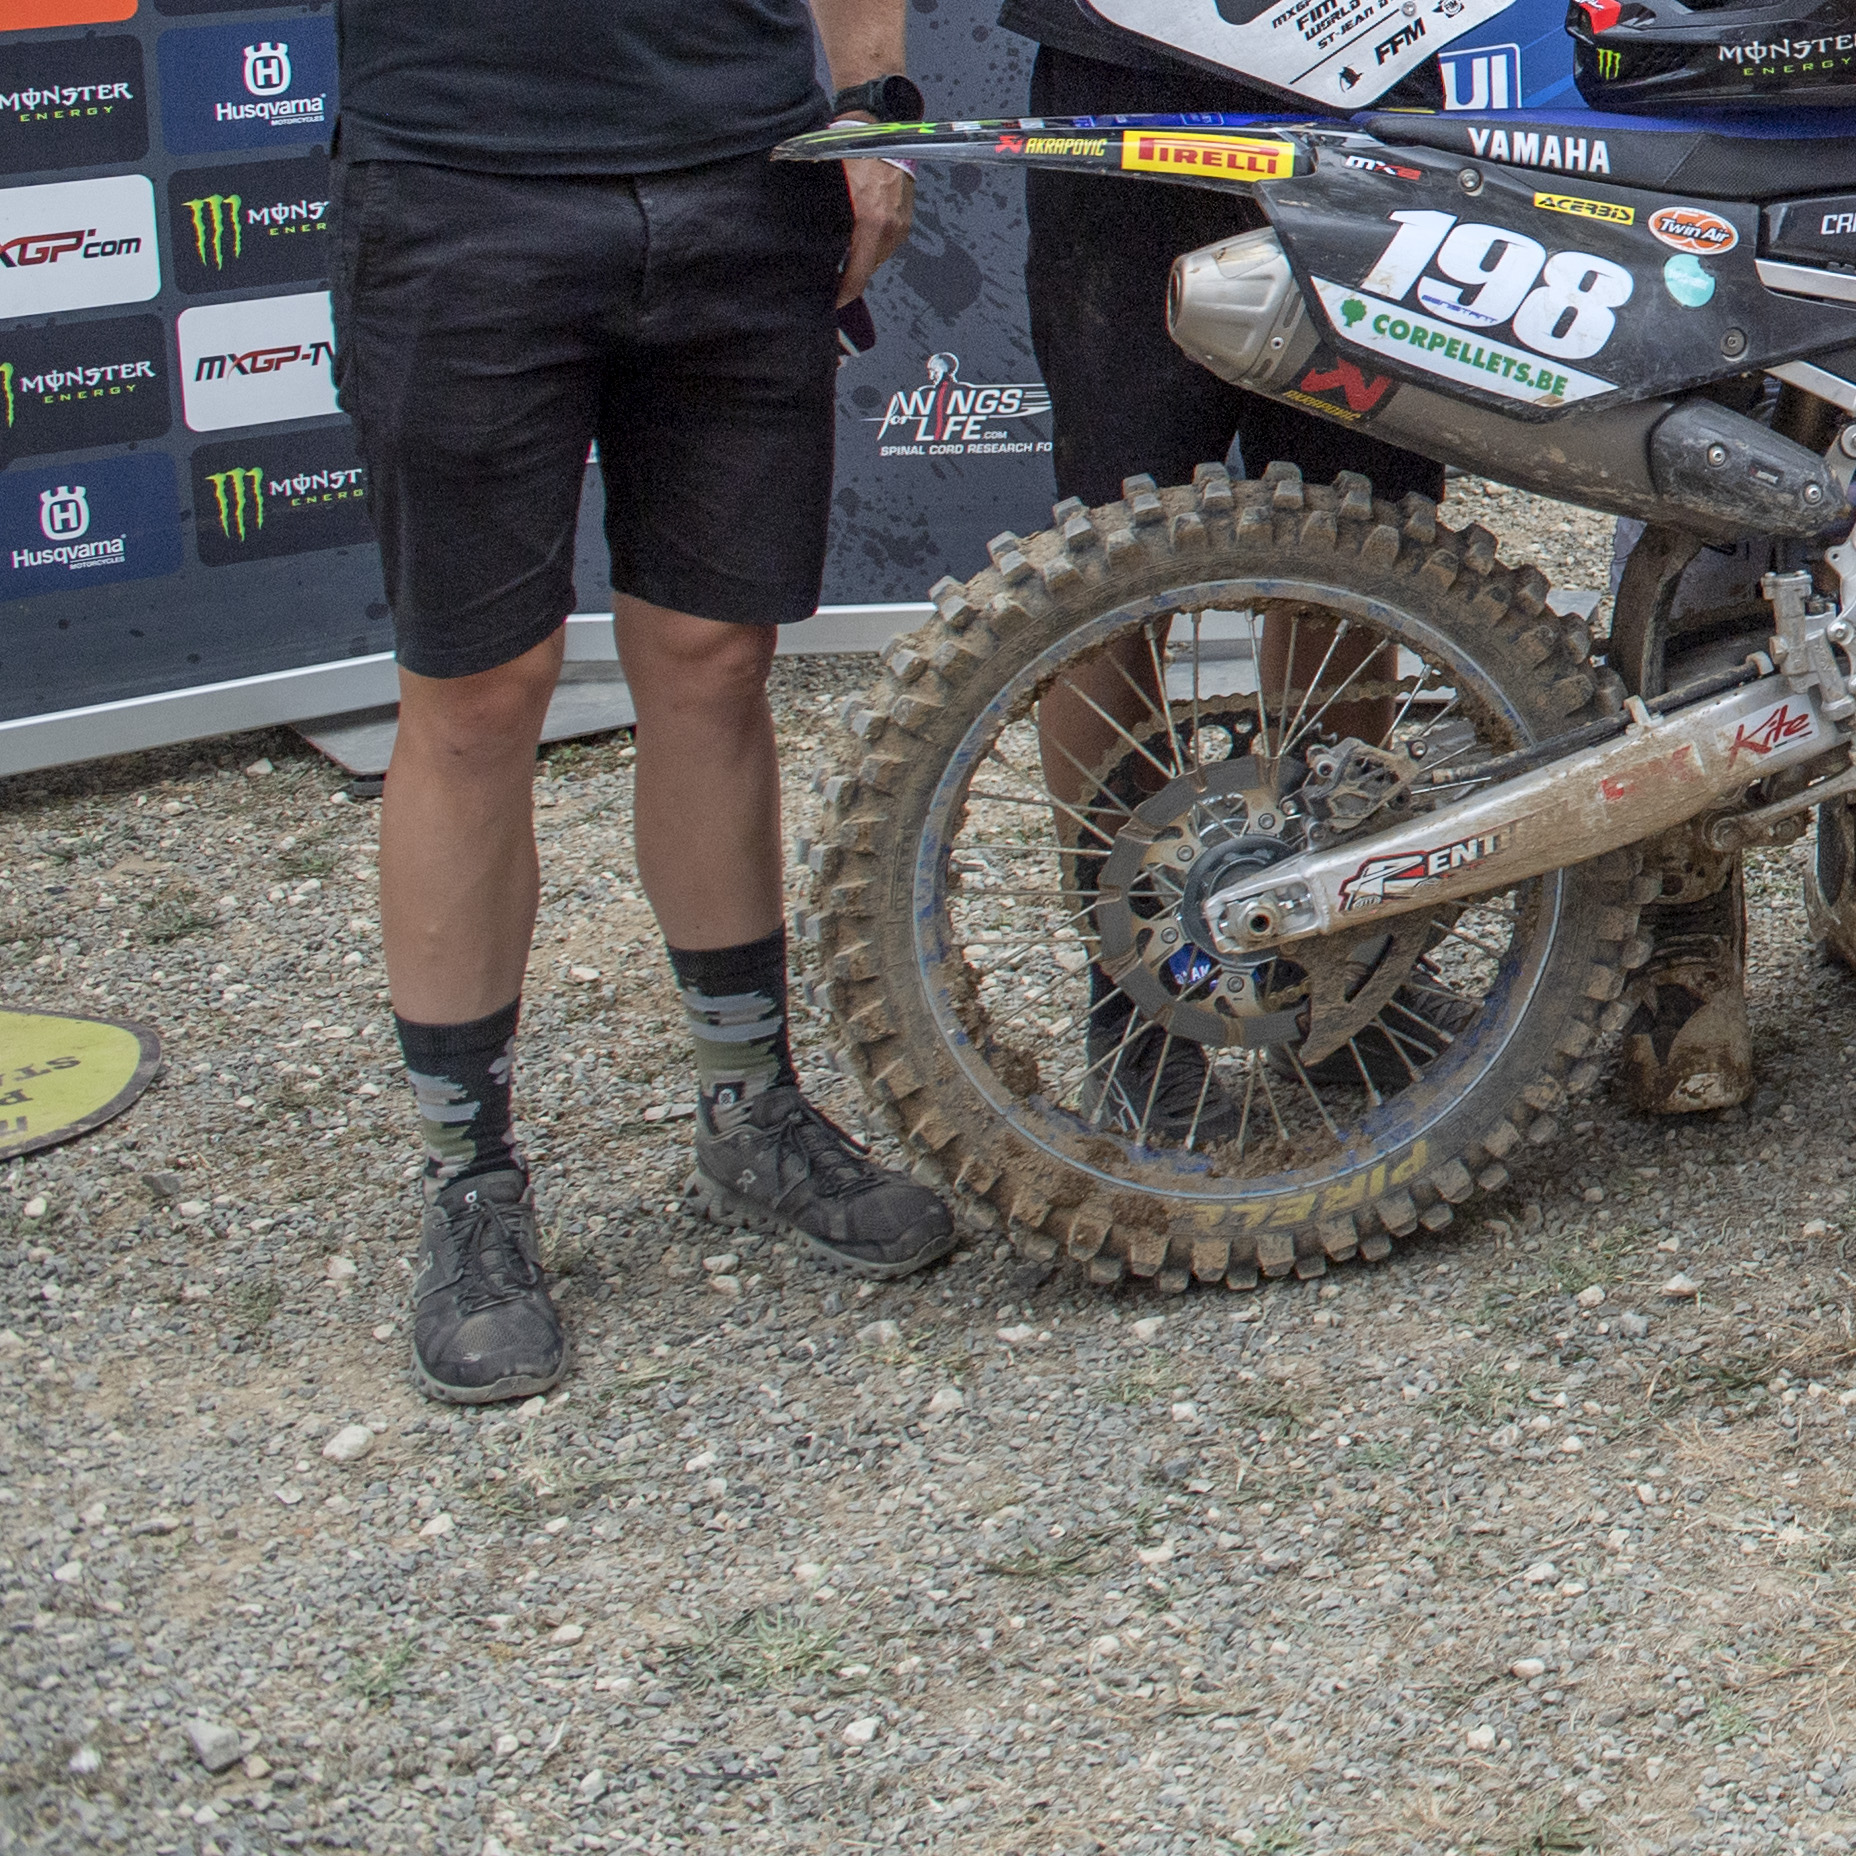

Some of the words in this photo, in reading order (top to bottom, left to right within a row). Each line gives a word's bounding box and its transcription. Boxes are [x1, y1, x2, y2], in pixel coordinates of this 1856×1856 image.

[1317, 7, 1373, 49] ST-JEAN
[1374, 17, 1426, 66] FFM
[1744, 56, 1852, 77] ENERGY
[20, 106, 112, 122] ENERGY
[216, 96, 325, 122] Husqvarna
[1139, 136, 1280, 176] PIRELLI
[1468, 127, 1610, 174] YAMAHA
[1538, 196, 1632, 221] ACERBIS
[1658, 218, 1702, 238] Twin
[1701, 227, 1729, 243] Air
[1361, 208, 1633, 359] 198
[1373, 313, 1568, 397] CORPELLETS.BE
[20, 361, 155, 393] MONSTER
[45, 384, 137, 403] ENERGY
[897, 389, 1023, 416] WINGS
[915, 416, 987, 441] LIFE
[880, 447, 925, 456] SPINAL
[929, 445, 963, 454] CORD
[968, 443, 1032, 453] RESEARCH
[12, 534, 126, 568] Husqvarna
[69, 556, 125, 570] MOTORCYCLES
[1728, 703, 1811, 768] Kite
